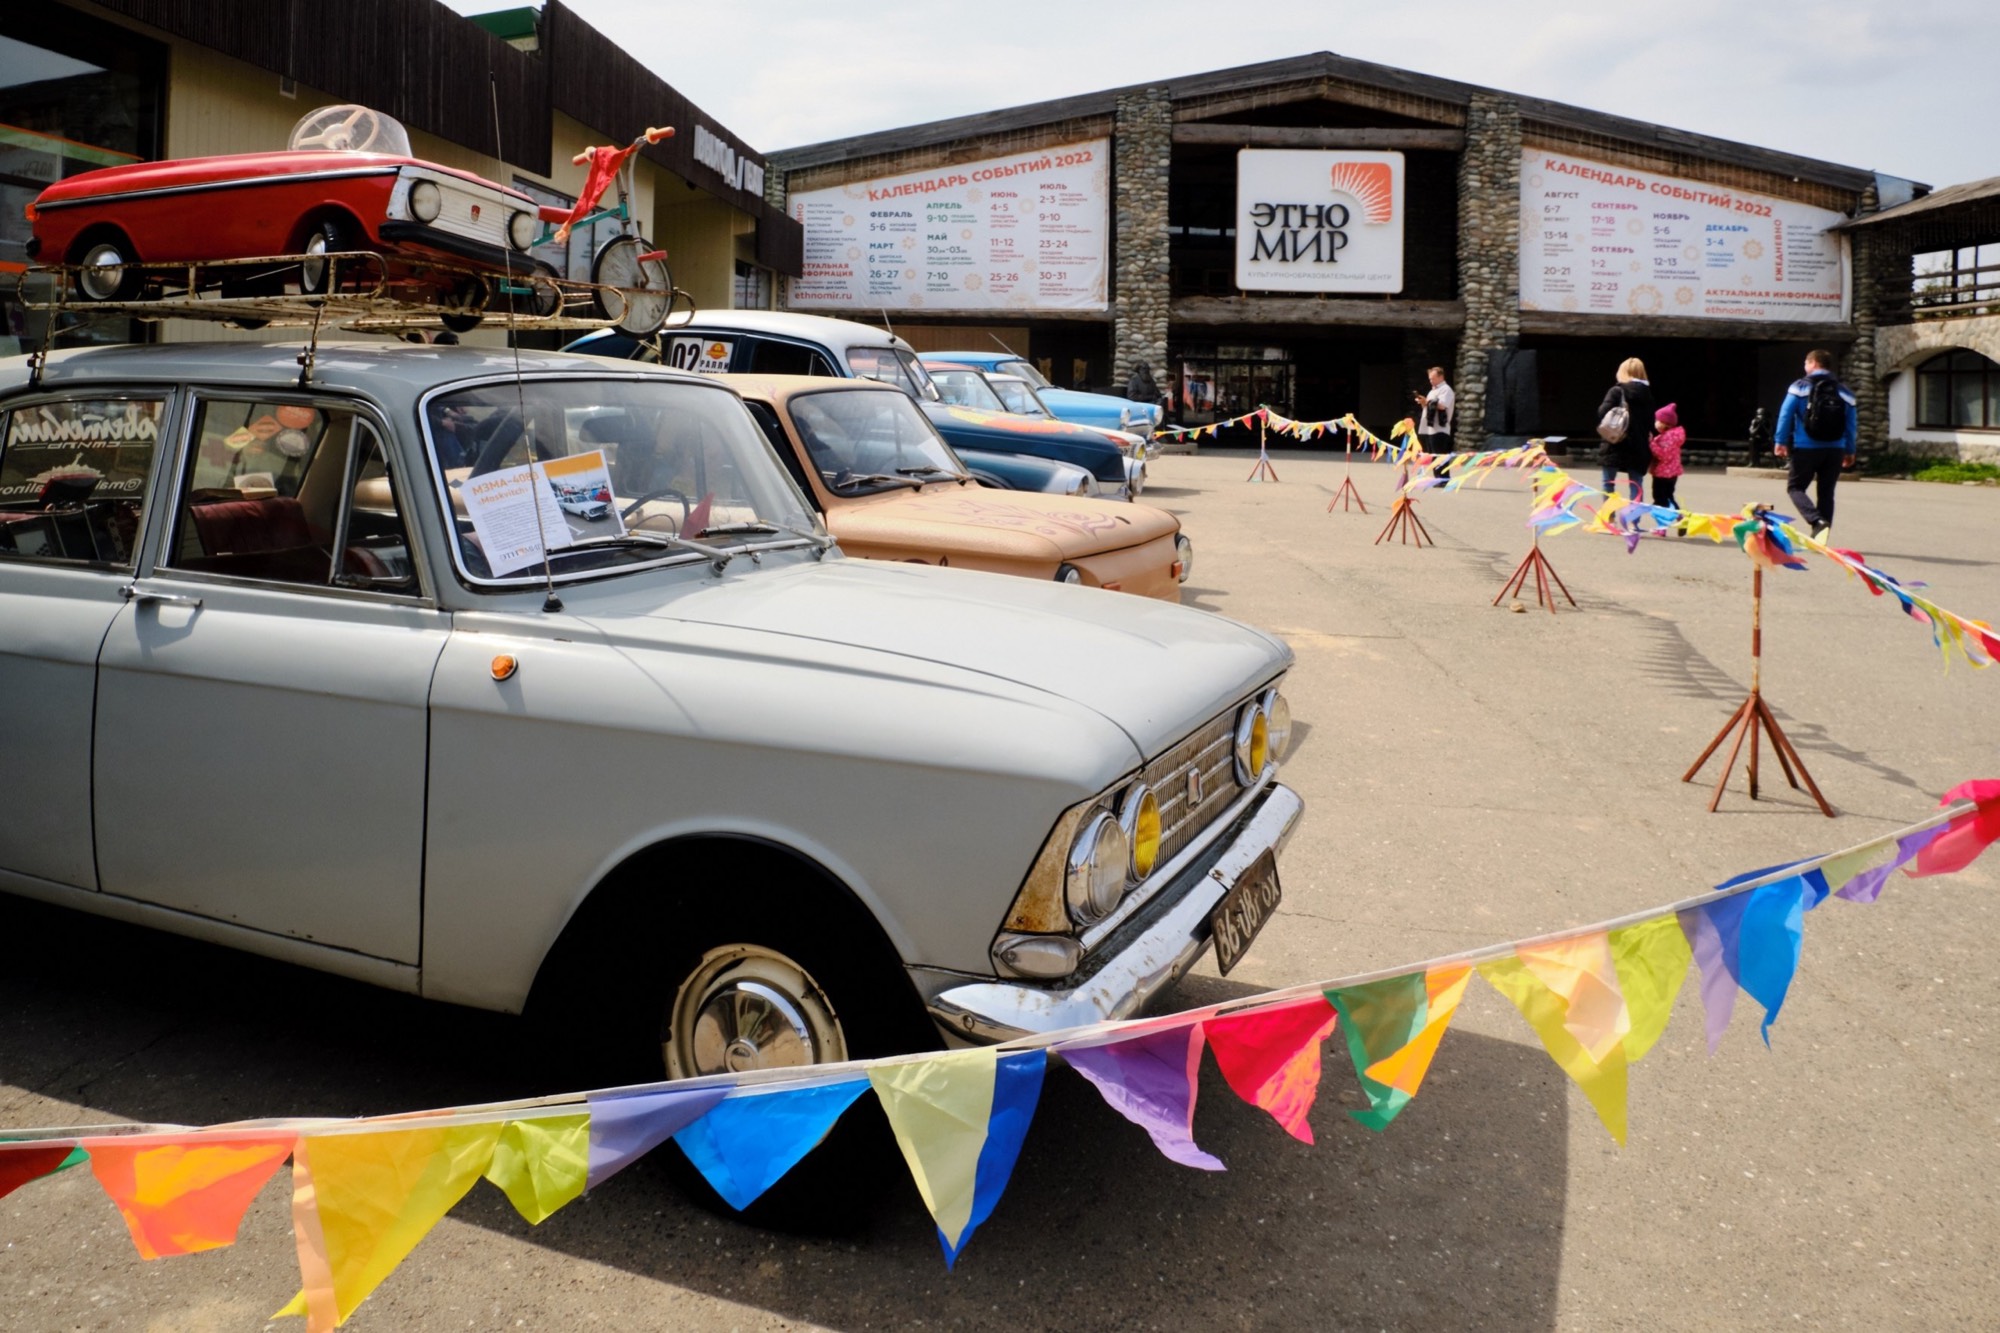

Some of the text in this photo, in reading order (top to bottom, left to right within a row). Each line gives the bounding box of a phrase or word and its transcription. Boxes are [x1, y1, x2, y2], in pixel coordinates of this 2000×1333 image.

[868, 150, 1093, 201] КАЛЕНДАРЬ СОБЫТИЙ 2022
[1545, 159, 1772, 218] КАЛЕНДАРЬ СОБЫТИЙ 2022
[1039, 195, 1056, 204] 2-3
[1544, 191, 1579, 199] АВГУСТ
[926, 202, 963, 210] АПРЕЛЬ
[990, 203, 1009, 212] 4-5
[1543, 204, 1561, 214] 6-7
[1591, 202, 1639, 211] СЕНТЯБРЬ
[926, 214, 948, 223] 9-10
[1039, 213, 1061, 221] 9-10
[1249, 202, 1350, 229] ЭТНО
[1653, 212, 1690, 221] НОЯБРЬ
[869, 222, 887, 232] 5-6
[1653, 225, 1671, 235] 5-6
[1705, 224, 1749, 233] ДЕКАБРЬ
[869, 242, 894, 250] МАРТ
[990, 237, 1014, 247] 11-12
[1039, 239, 1069, 249] 23-24
[1249, 228, 1349, 263] МИР
[1706, 237, 1725, 247] 3-4
[1591, 246, 1635, 254] ОКТЯБРЬ
[1774, 219, 1783, 282] ЕЖЕДНЕВНО
[869, 254, 876, 264] 6
[1591, 259, 1606, 269] 1-2
[1653, 257, 1678, 267] 12-13
[869, 269, 899, 279] 26-27
[926, 271, 948, 281] 7-10
[1039, 271, 1067, 280] 30-31
[1543, 266, 1571, 276] 20-21
[990, 272, 1019, 282] 25-26
[1590, 281, 1619, 292] 22-23
[794, 291, 852, 301] ethnomir.ru
[1705, 289, 1770, 298] АКТУАЛЬНАЯ
[1705, 306, 1764, 315] ethnomir.ru
[671, 343, 700, 371] 02
[700, 360, 729, 370] РАЛЛИ
